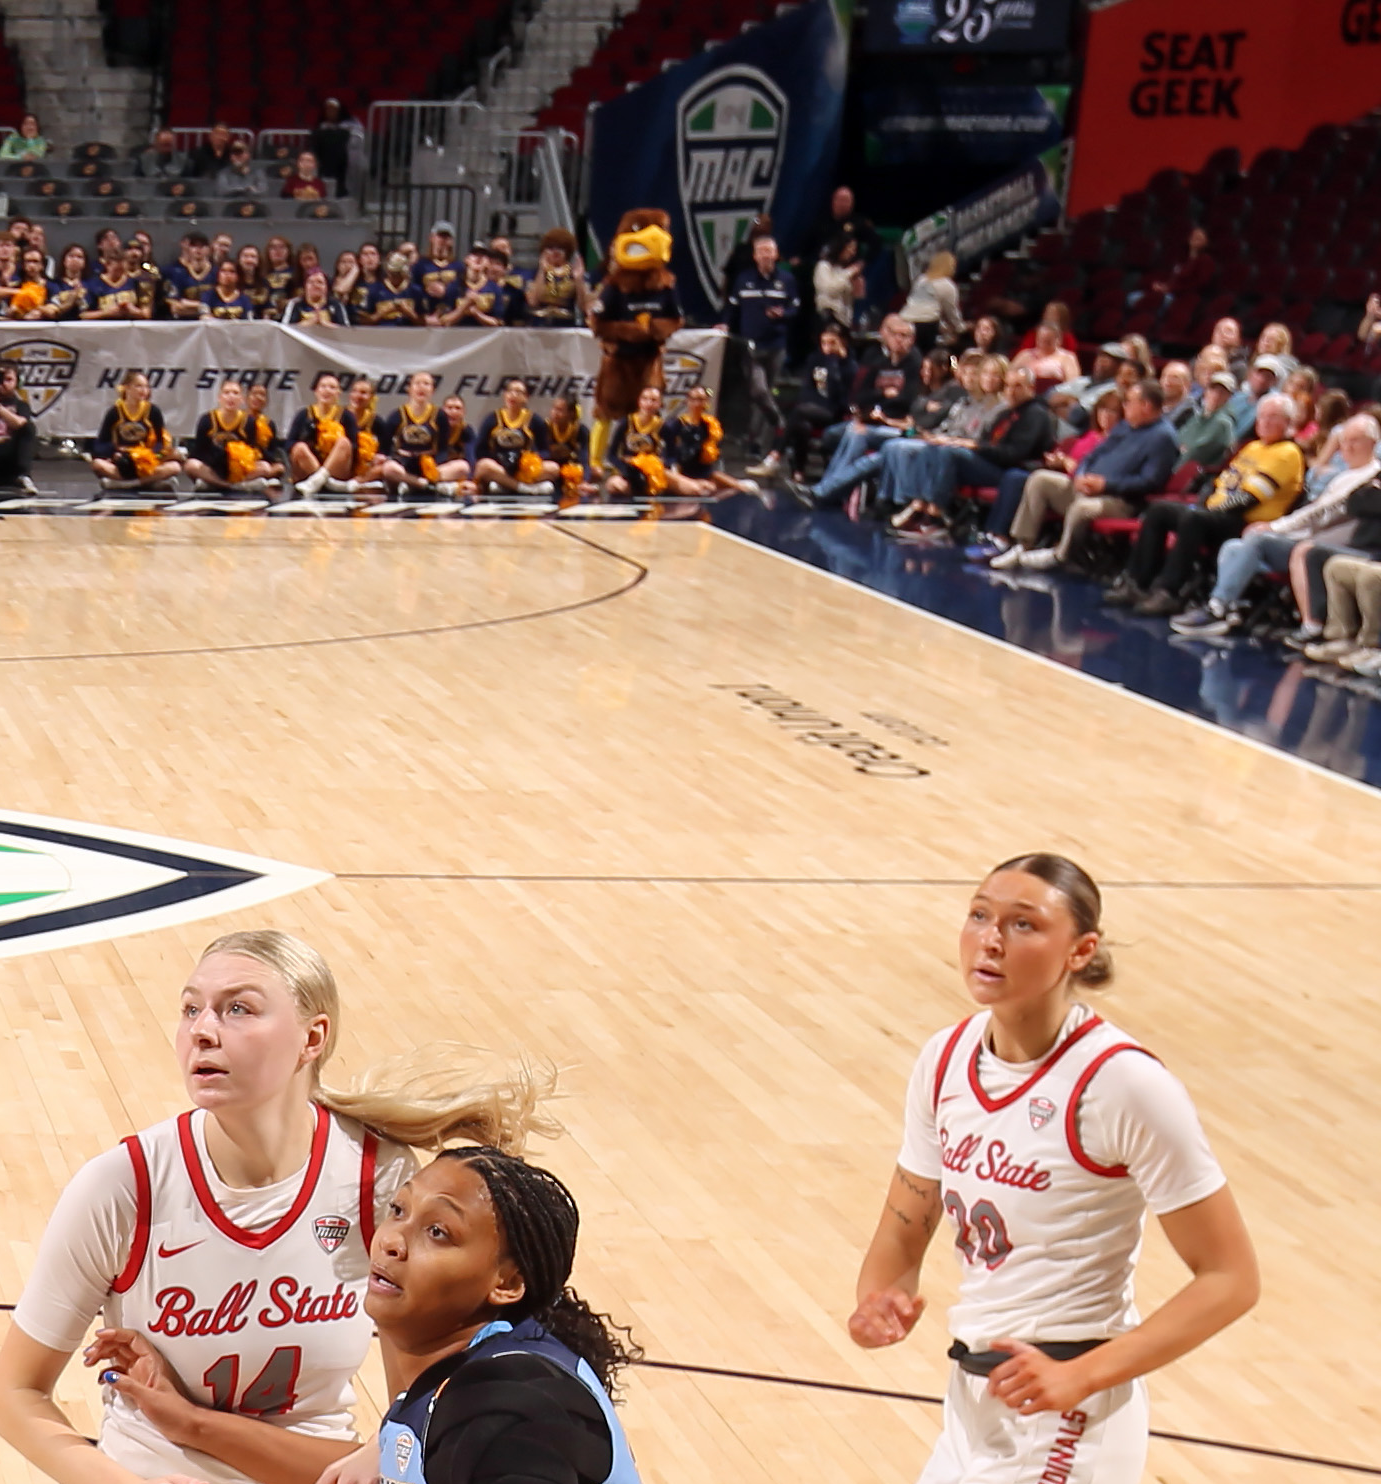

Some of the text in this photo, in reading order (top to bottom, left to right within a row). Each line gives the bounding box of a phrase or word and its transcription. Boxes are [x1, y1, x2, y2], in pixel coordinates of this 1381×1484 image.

[1140, 29, 1246, 73] SEAT
[1129, 77, 1243, 119] GEEK
[689, 147, 776, 202] MAC
[96, 368, 186, 389] KNT
[975, 1139, 1052, 1192] State
[147, 1275, 359, 1338] Ball State
[202, 1345, 303, 1416] 14
